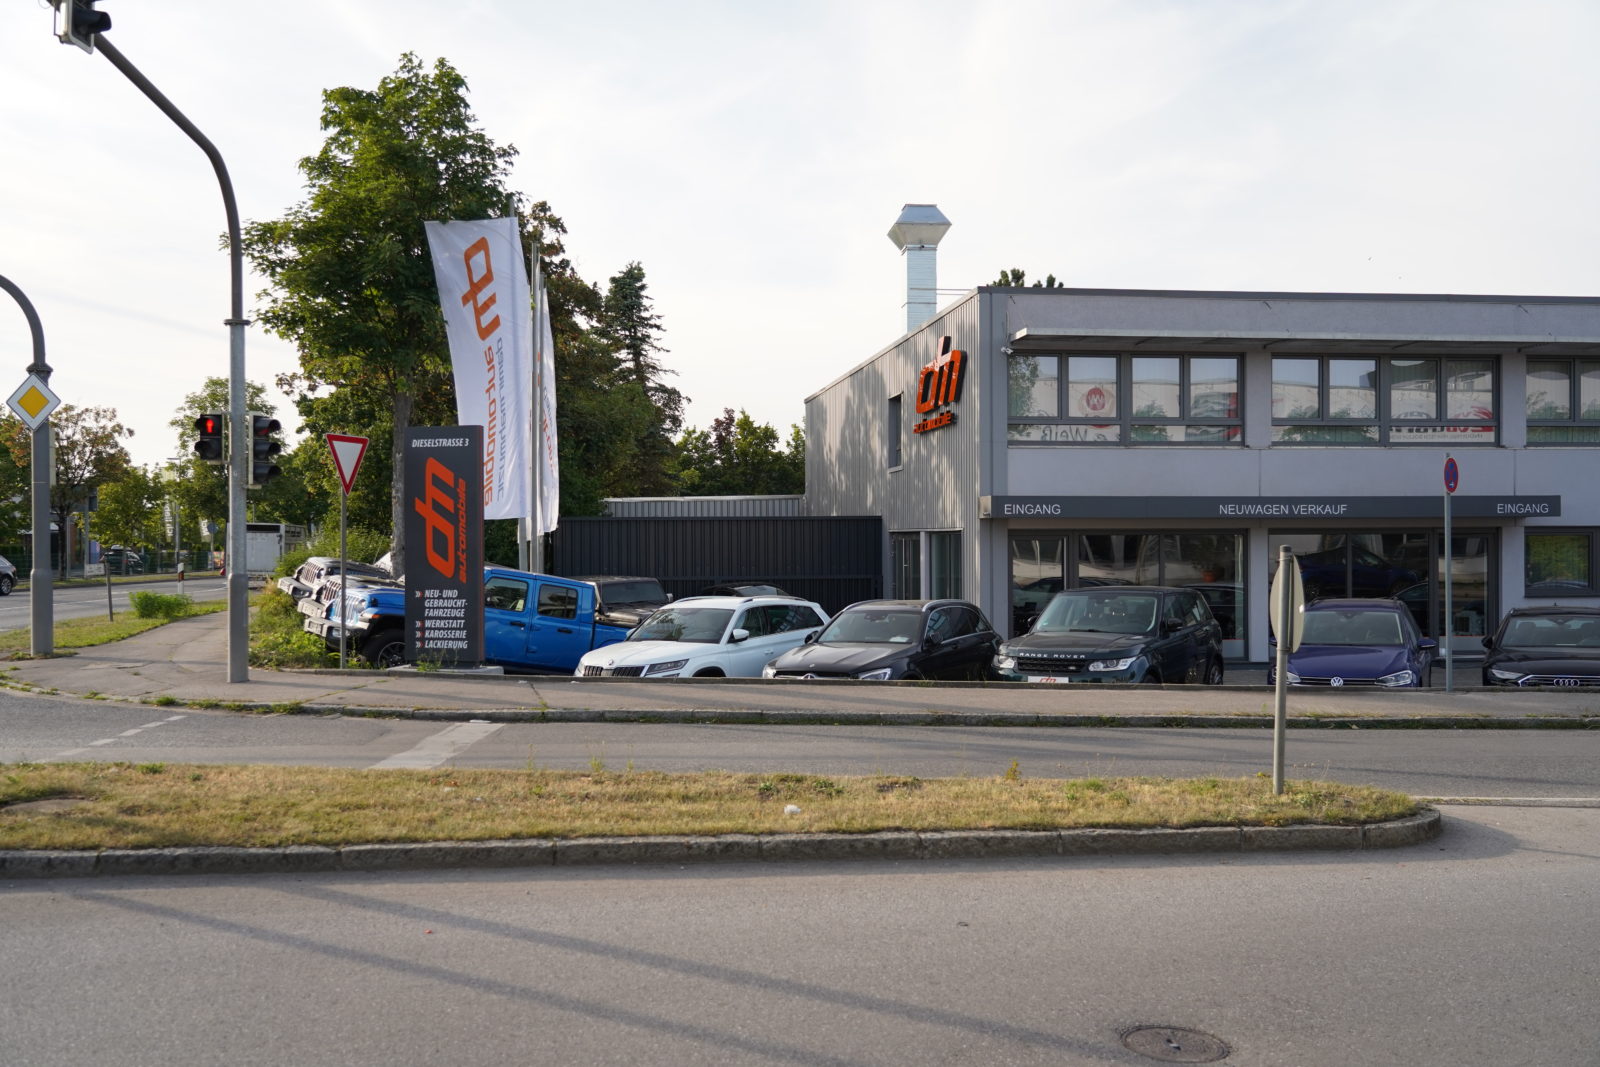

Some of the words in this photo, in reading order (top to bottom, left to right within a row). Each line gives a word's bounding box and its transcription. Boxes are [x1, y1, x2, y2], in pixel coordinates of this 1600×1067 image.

[411, 438, 463, 448] DIESELSTRASSE
[464, 438, 469, 447] 3
[1004, 504, 1061, 515] EINGANG
[1219, 504, 1289, 515] NEUWAGEN
[1291, 504, 1348, 515] VERKAUF
[1497, 503, 1549, 514] EINGANG
[457, 477, 467, 584] automobile
[424, 589, 442, 598] NEU-
[442, 589, 458, 598] UND
[424, 599, 468, 608] GEBRAUCHT-
[424, 608, 466, 617] FAHRZEUGE
[424, 619, 466, 628] WERKSTATT
[424, 629, 467, 639] KAROSSERIE
[424, 639, 469, 649] LACKIERUNG
